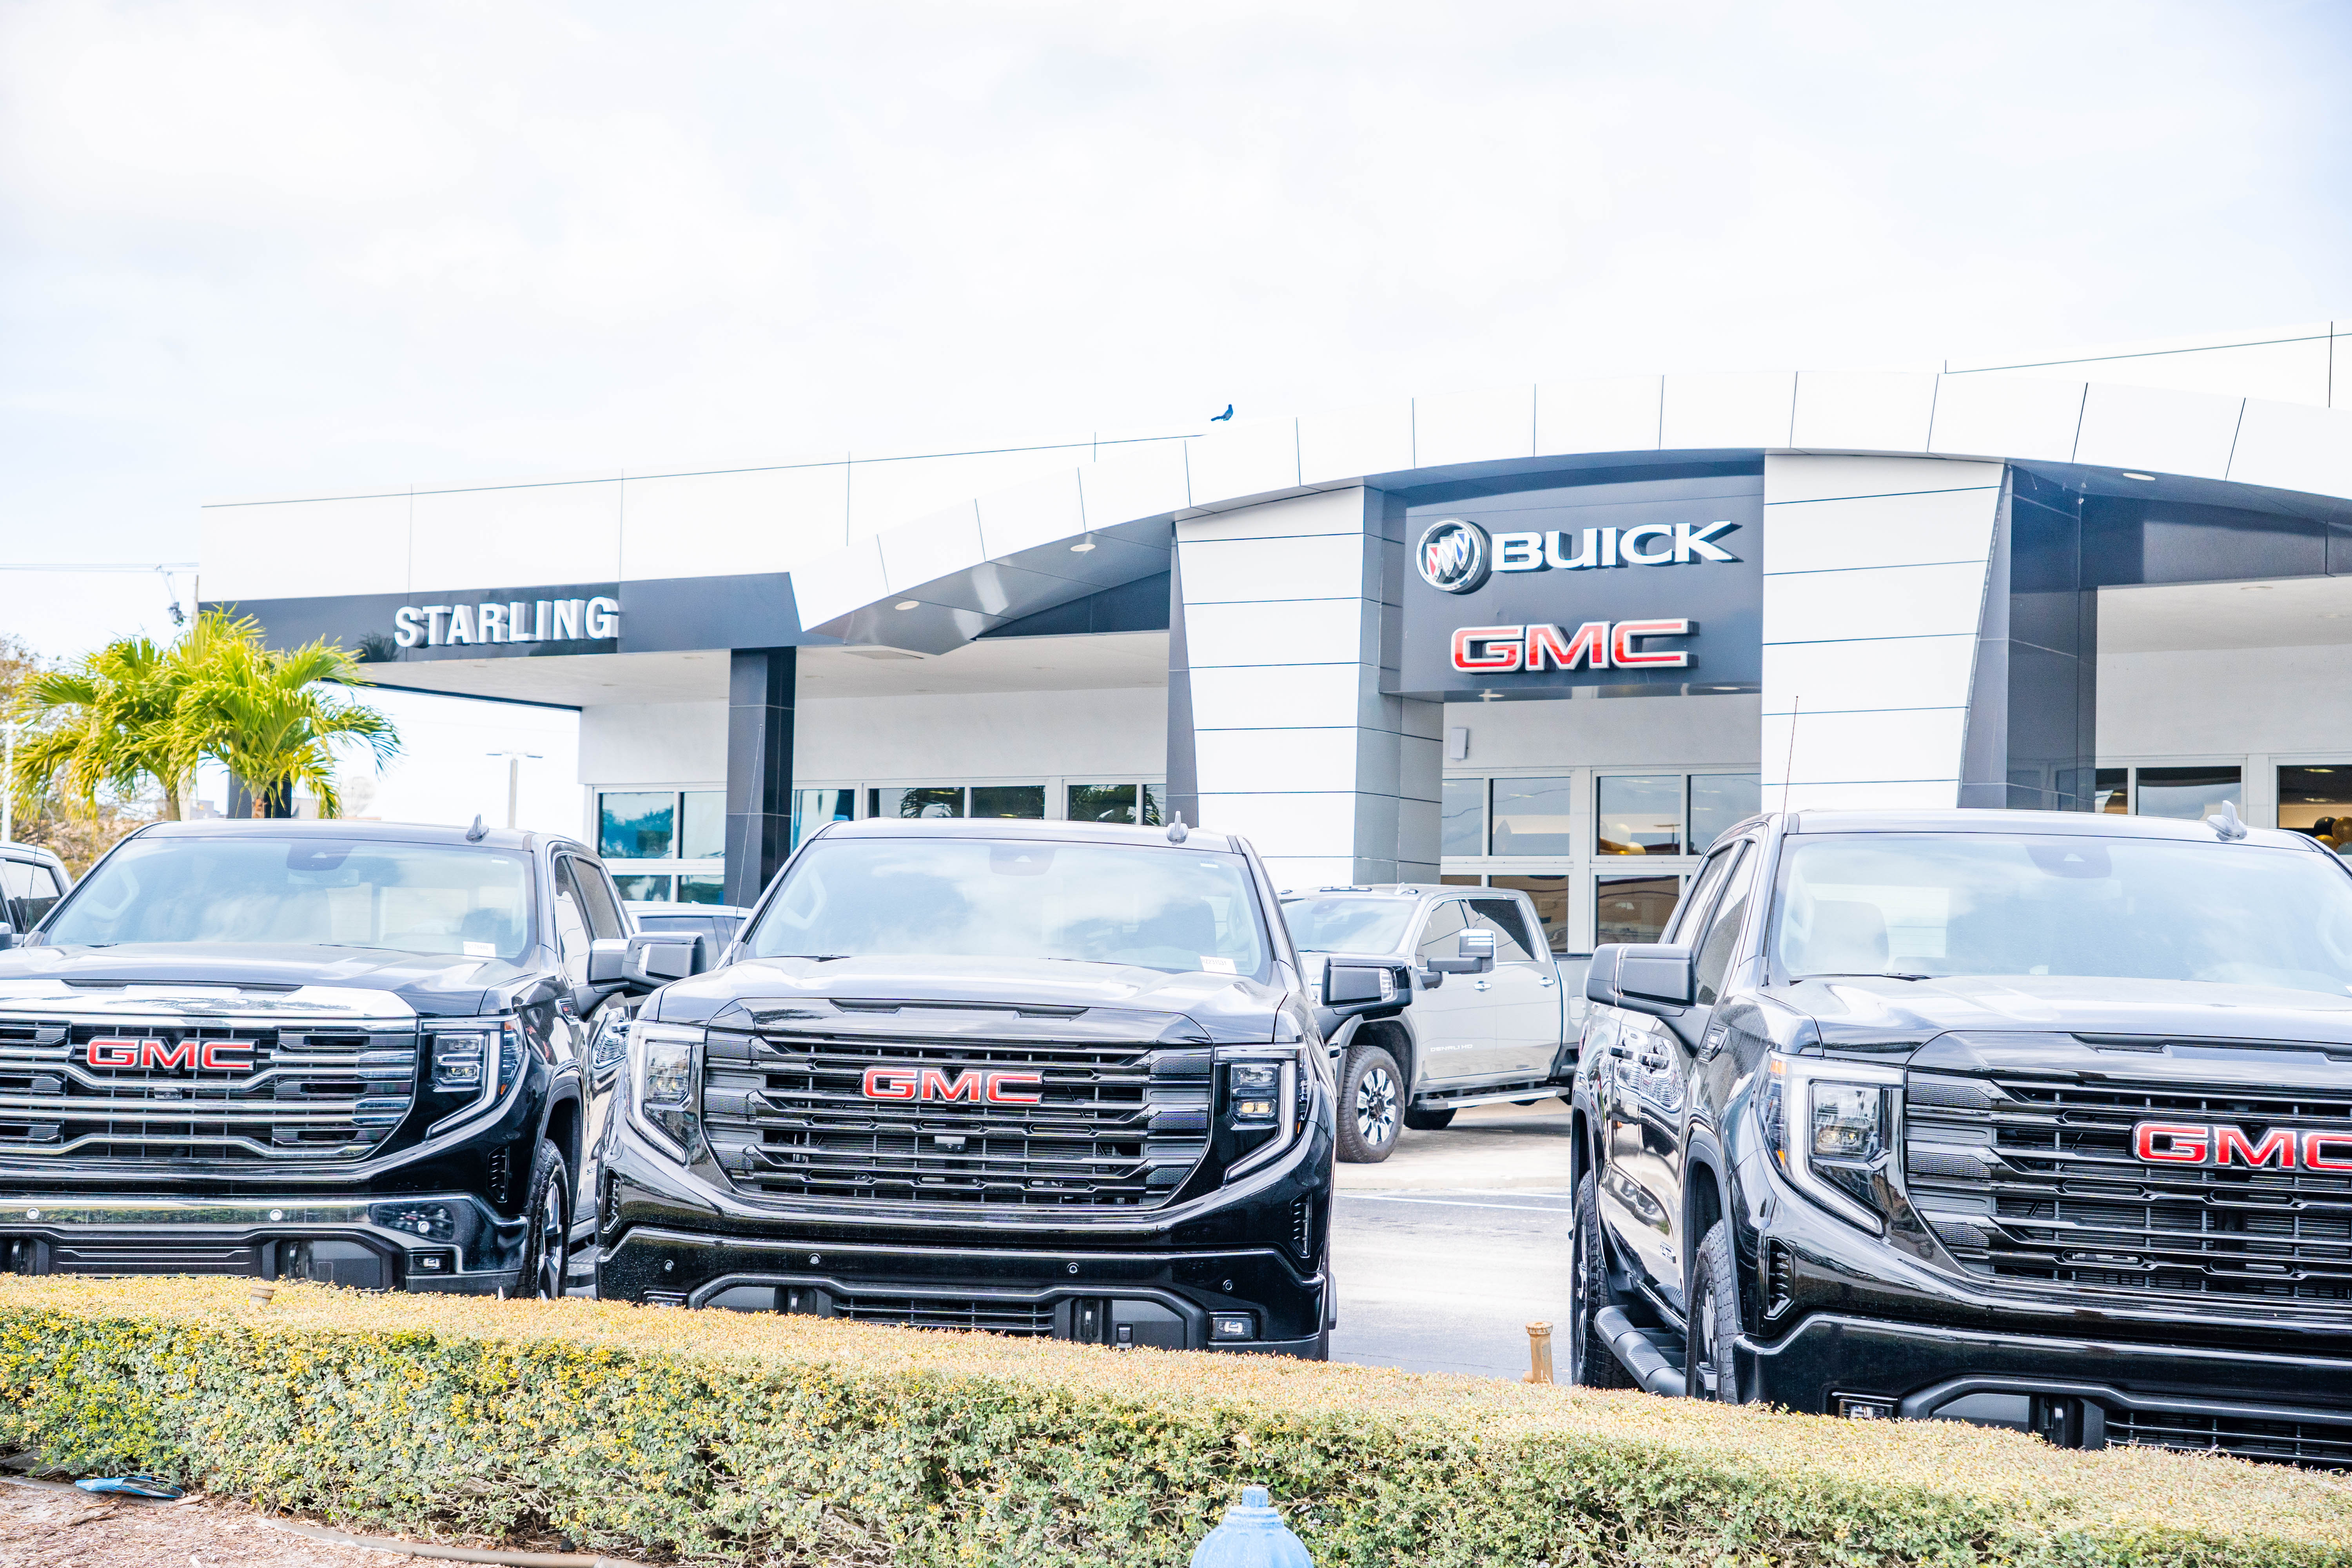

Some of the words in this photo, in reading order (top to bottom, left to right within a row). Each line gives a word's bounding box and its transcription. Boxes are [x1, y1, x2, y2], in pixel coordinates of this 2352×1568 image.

[1491, 521, 1733, 571] BUICK
[394, 596, 619, 648] STARLING
[1450, 618, 1689, 672] GMC
[86, 1038, 257, 1071] GMC
[862, 1066, 1044, 1105] GMC
[2134, 1121, 2352, 1171] GMC
